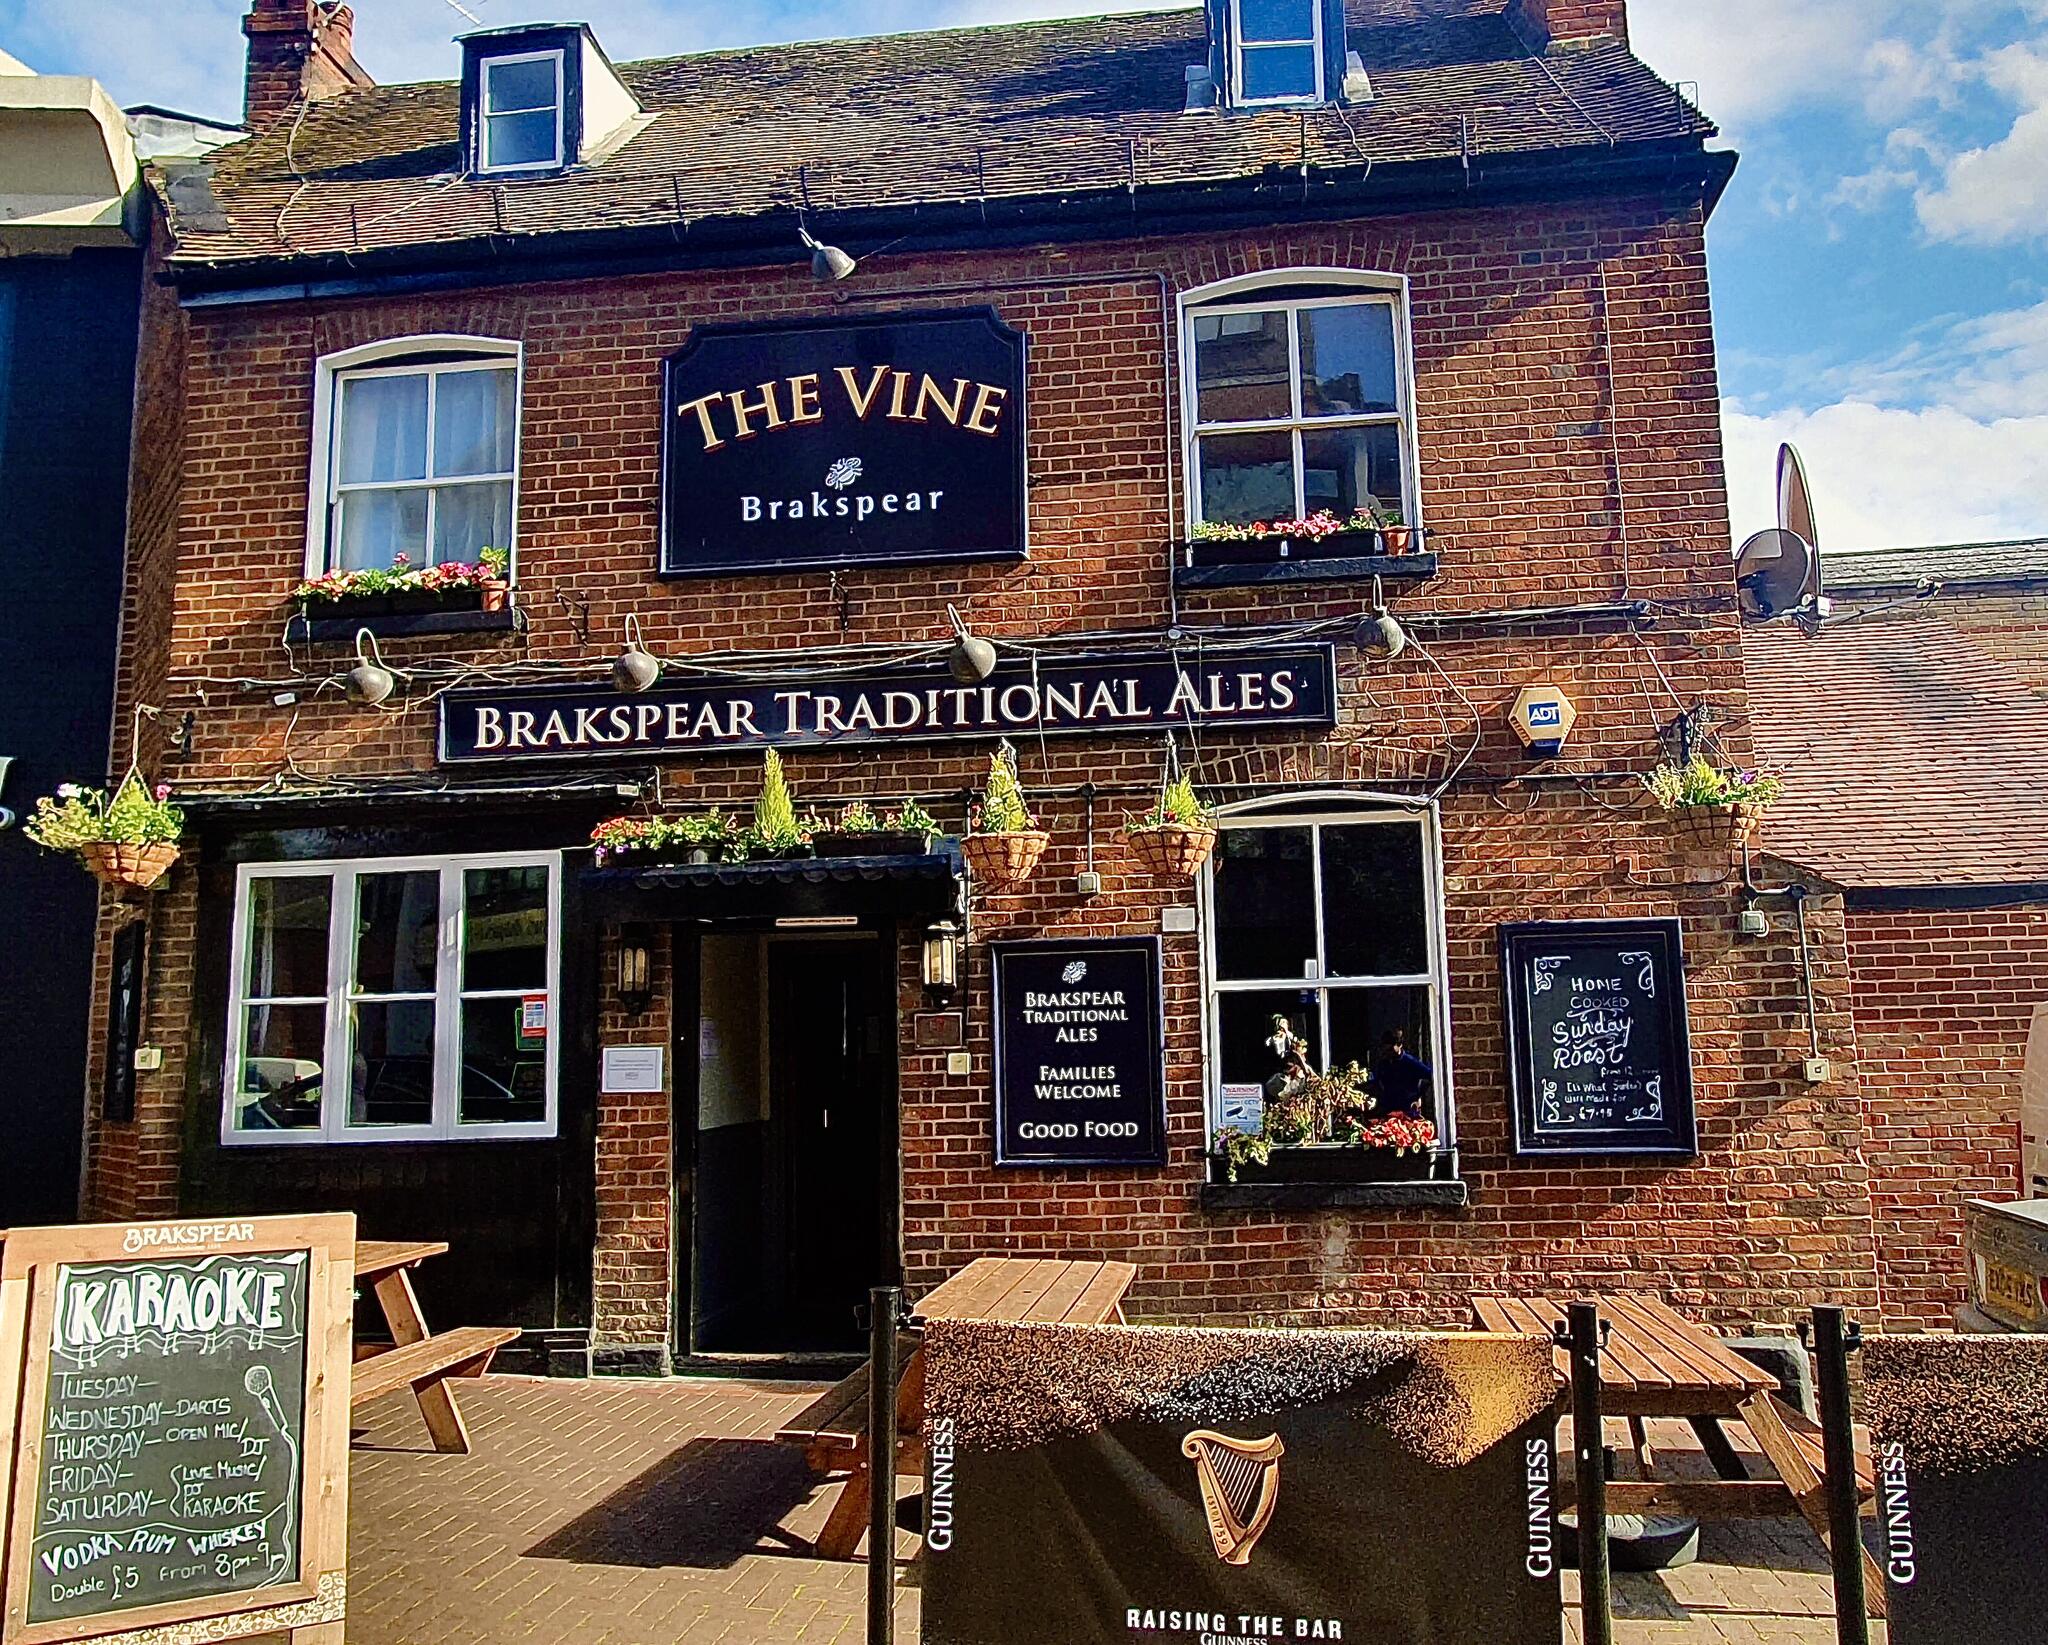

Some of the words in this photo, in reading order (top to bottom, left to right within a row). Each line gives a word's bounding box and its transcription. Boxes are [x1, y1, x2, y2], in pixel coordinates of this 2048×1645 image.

[678, 373, 822, 449] THE
[834, 365, 1007, 433] VINE
[741, 490, 943, 522] Brakspear
[473, 699, 762, 748] BRAKSPEAR
[774, 678, 1150, 734] TRADITIONAL
[1164, 670, 1294, 714] ALES
[1530, 707, 1558, 721] ADT
[1571, 977, 1623, 992] HOME
[1025, 991, 1126, 1008] BRAKSPEAR
[1570, 996, 1630, 1009] COOKED
[1023, 1009, 1128, 1024] TRADITIONAL
[1552, 1011, 1632, 1047] Sunday
[1055, 1027, 1098, 1042] ALES
[1553, 1044, 1623, 1069] Roast
[1039, 1066, 1116, 1081] FAMILIES
[1034, 1084, 1121, 1099] WELCOME
[1019, 1123, 1078, 1138] GOOD
[1084, 1121, 1138, 1137] FOOD
[122, 1223, 255, 1253] BRAKSPEAR
[64, 1267, 285, 1346] KARAOKE
[166, 1426, 208, 1441] OPEN
[182, 1466, 216, 1481] LIVE
[927, 1416, 954, 1551] GUINNESS
[183, 1491, 266, 1519] KARAOKE
[1526, 1438, 1552, 1578] GUINNESS
[1881, 1442, 1916, 1585] GUINNESS
[41, 1535, 123, 1576] VODKA
[127, 1530, 177, 1555] RUM
[186, 1520, 267, 1557] WHISKEY
[50, 1578, 106, 1603] Double
[111, 1565, 140, 1600] £5
[159, 1564, 207, 1581] from
[1127, 1608, 1226, 1633] RAISING
[1238, 1615, 1283, 1637] THE
[1296, 1619, 1343, 1640] BAR
